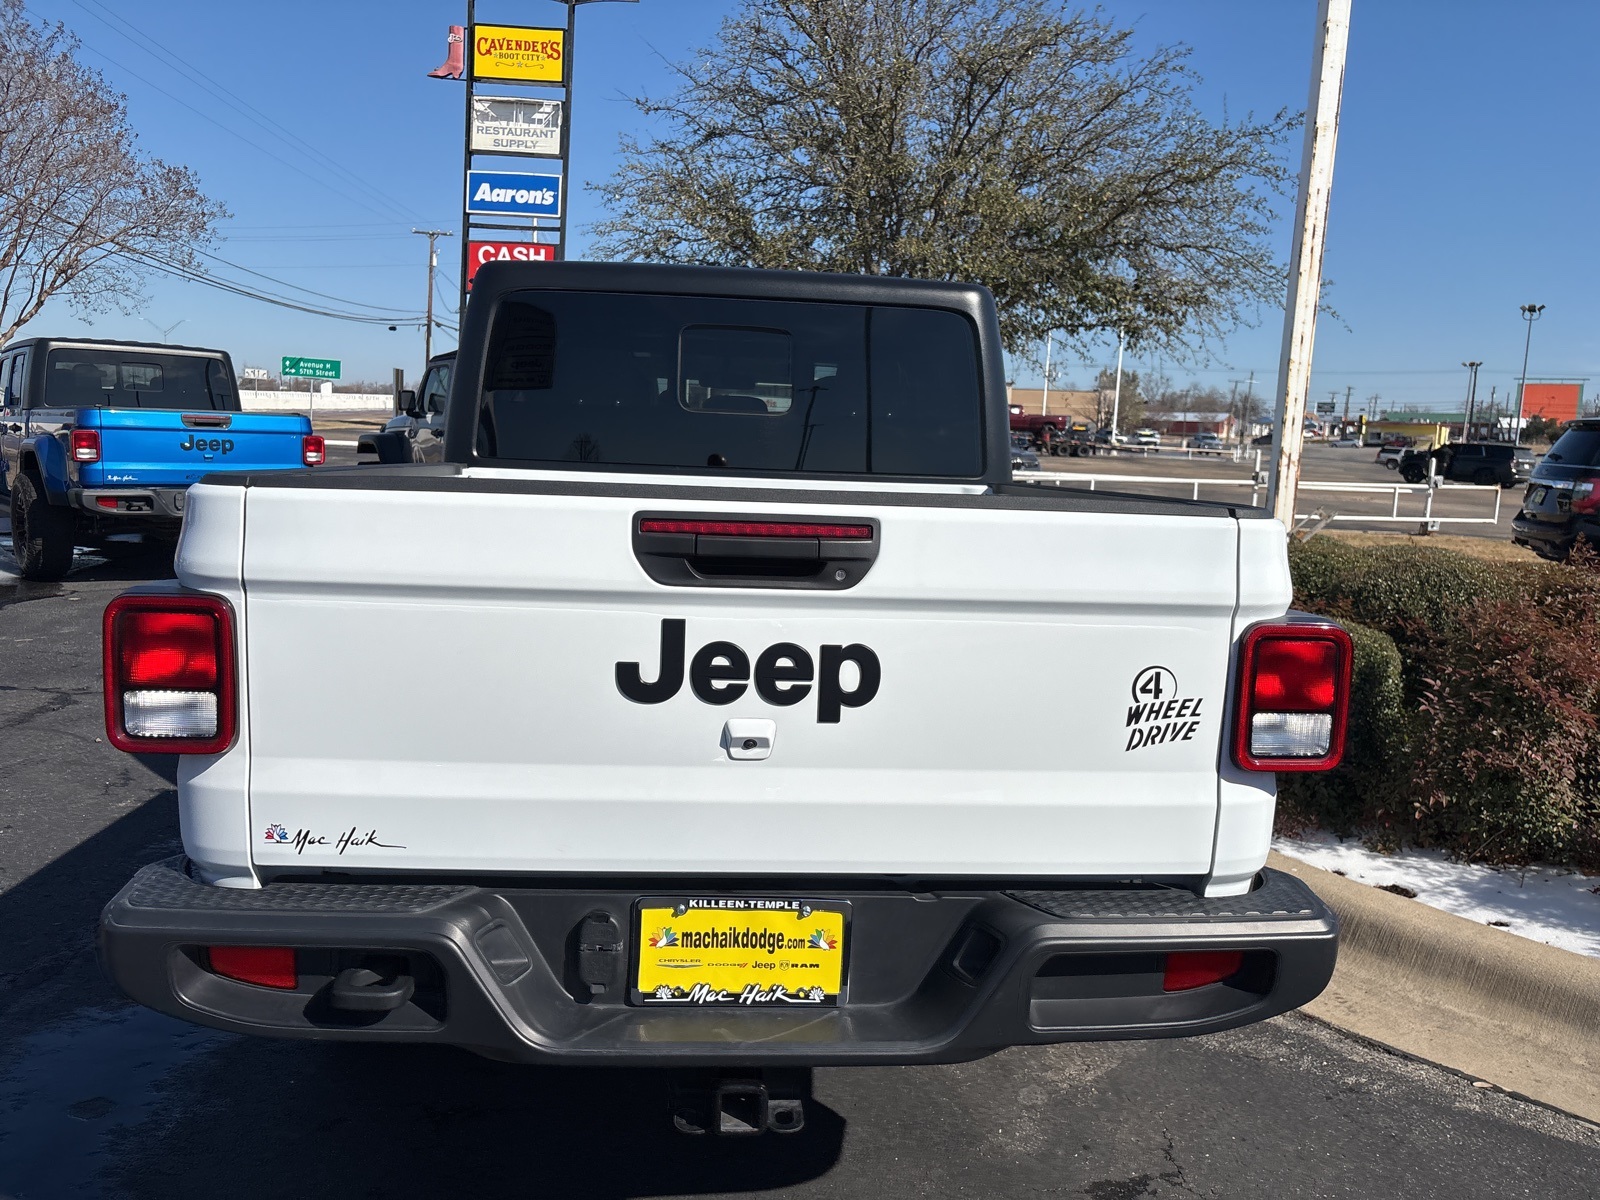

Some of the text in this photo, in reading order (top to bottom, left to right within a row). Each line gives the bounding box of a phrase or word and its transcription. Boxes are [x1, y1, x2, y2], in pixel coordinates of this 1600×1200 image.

[477, 36, 561, 60] CAVENDER'S
[498, 52, 541, 62] BOOT CITY
[476, 126, 556, 139] RESTAURANT
[493, 138, 539, 149] SUPPLY
[473, 182, 555, 205] Aaron's
[478, 245, 546, 264] CASH
[299, 361, 324, 369] Avenue
[315, 369, 336, 377] Street
[180, 434, 234, 454] Jeep
[615, 618, 881, 723] Jeep
[1139, 671, 1163, 699] 4
[1126, 698, 1204, 727] WHEEL
[1125, 721, 1200, 752] DRIVE
[291, 827, 407, 855] Mac Haik
[689, 899, 800, 909] KILLEEN-TEMPLE
[681, 927, 806, 954] machaikdodge.com
[752, 960, 776, 970] Jeep
[688, 983, 793, 1004] Mac Haik
